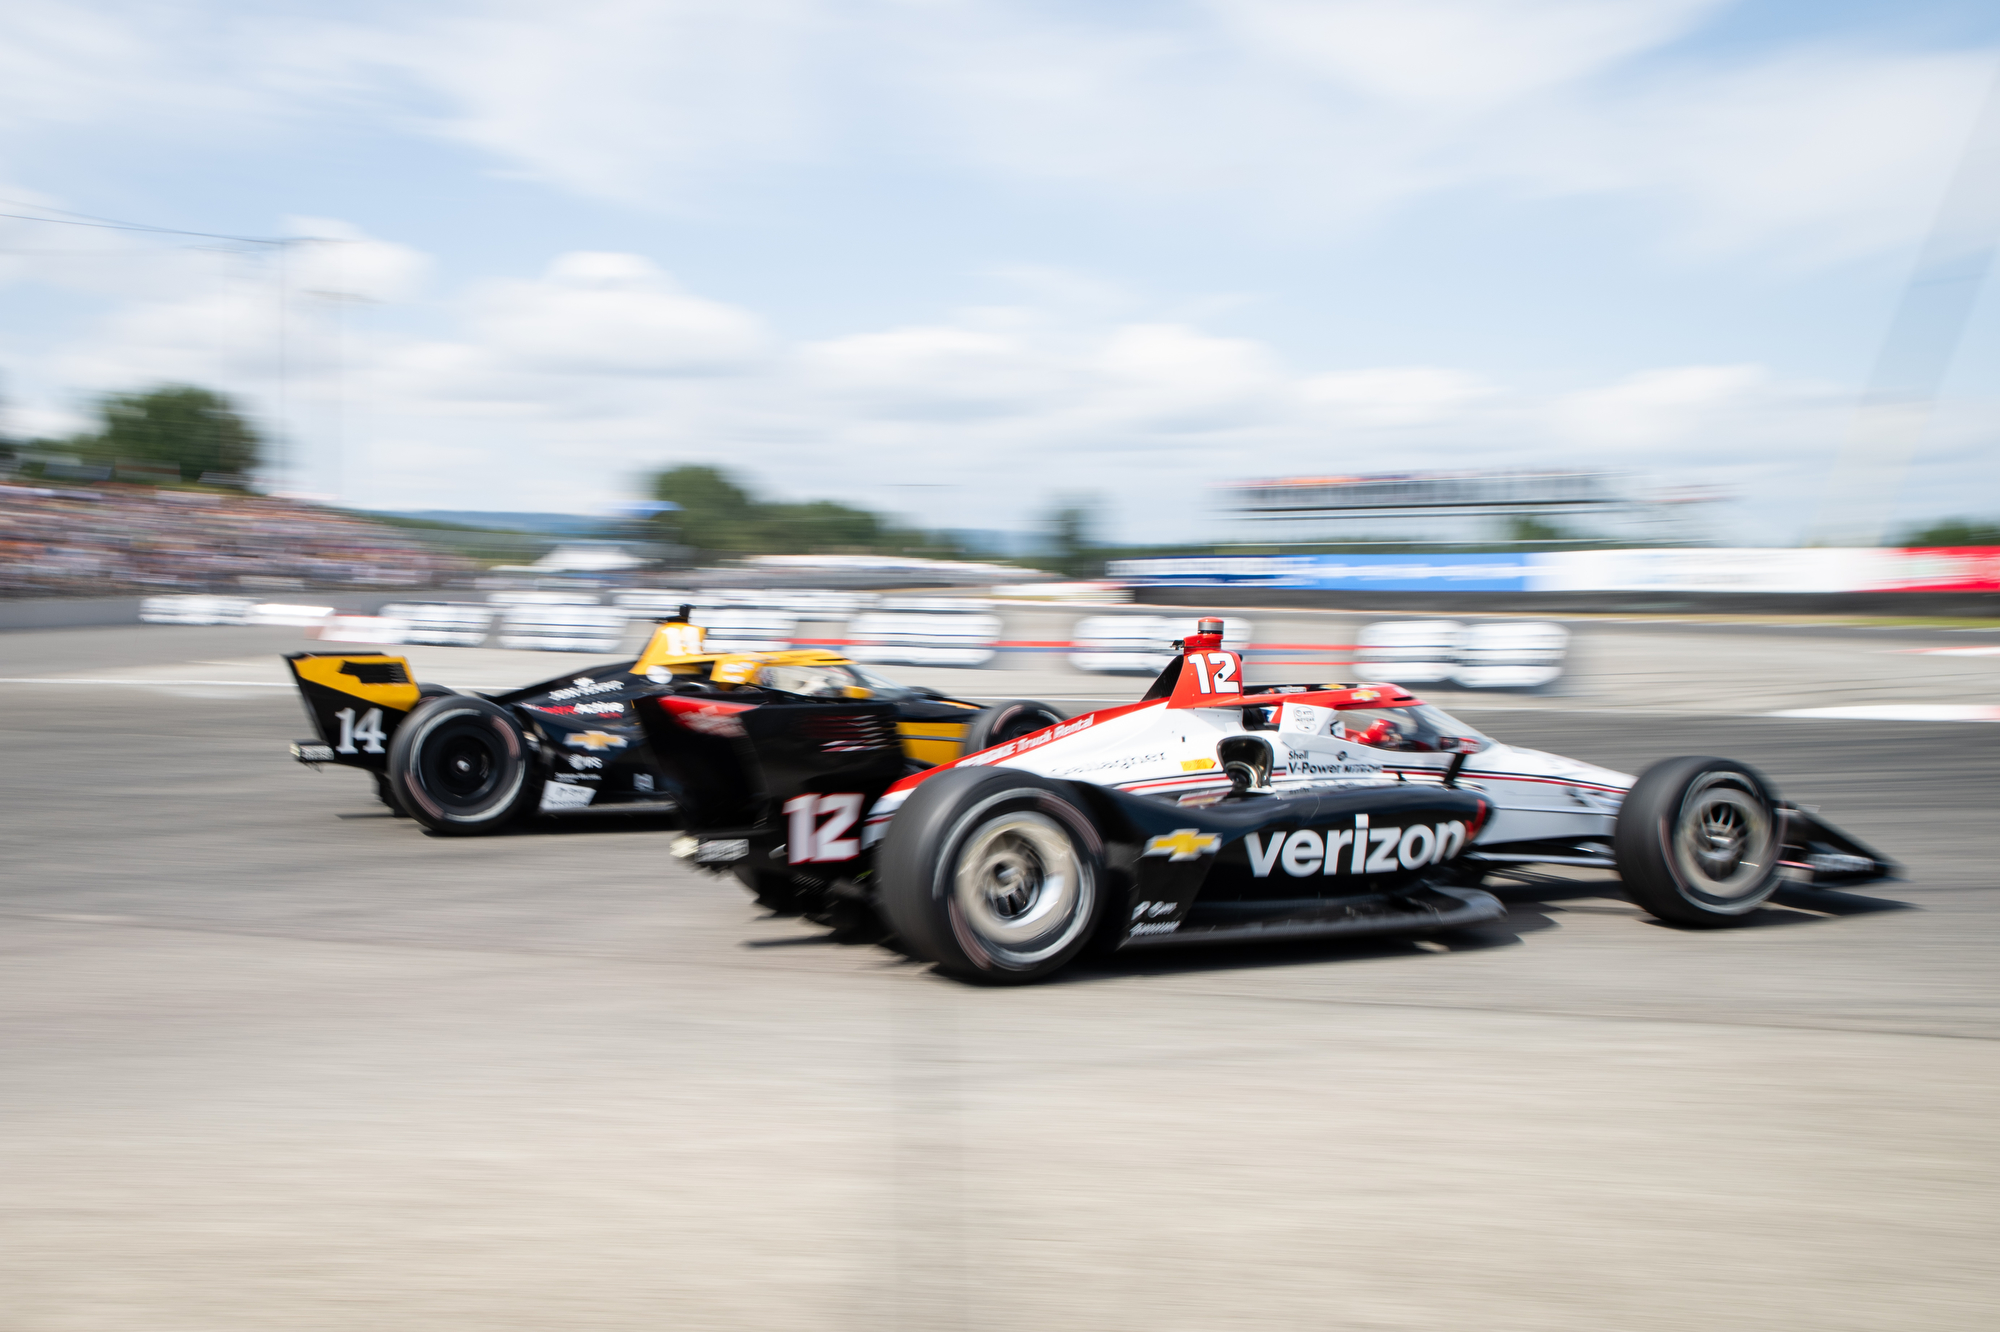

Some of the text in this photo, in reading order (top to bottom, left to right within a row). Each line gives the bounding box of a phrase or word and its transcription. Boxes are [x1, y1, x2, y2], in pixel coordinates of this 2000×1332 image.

[1187, 652, 1241, 695] 12
[334, 706, 388, 755] 14
[1016, 732, 1054, 753] Truck
[1053, 713, 1095, 741] Rental
[1288, 750, 1309, 760] Shell
[1288, 761, 1342, 774] V-Power
[781, 792, 866, 866] 12
[1243, 813, 1467, 878] verizon
